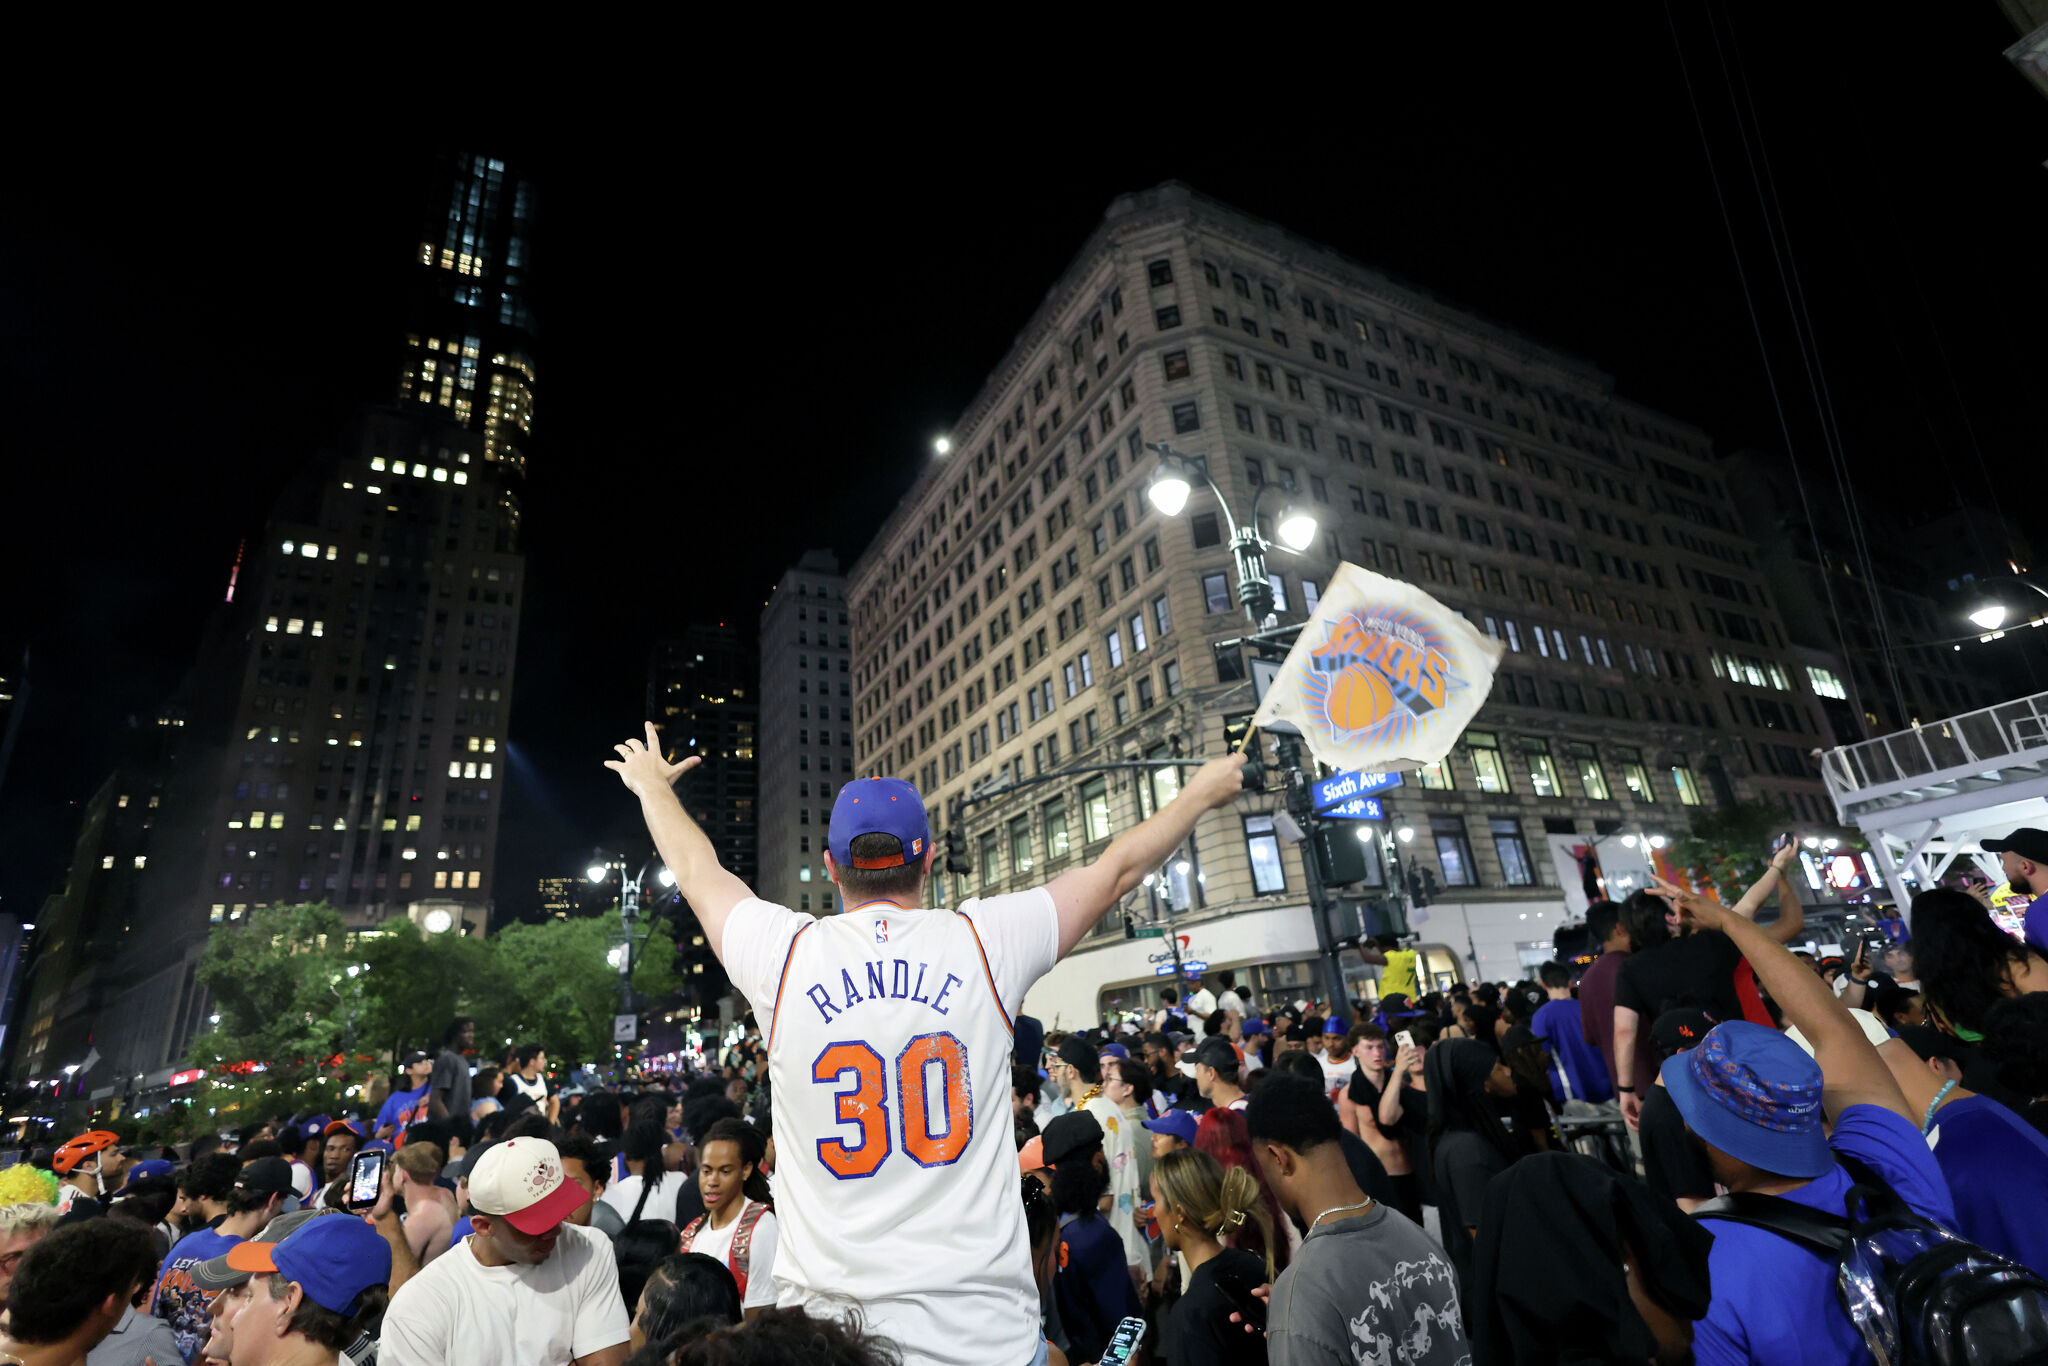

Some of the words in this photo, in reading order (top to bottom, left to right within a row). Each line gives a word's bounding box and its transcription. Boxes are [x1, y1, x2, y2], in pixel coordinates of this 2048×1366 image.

[1310, 614, 1449, 709] KNICKS
[1322, 776, 1357, 802] Sixth
[1360, 772, 1387, 790] Ave
[1367, 800, 1380, 816] St
[806, 958, 963, 1025] RANDLE
[811, 1030, 974, 1181] 30
